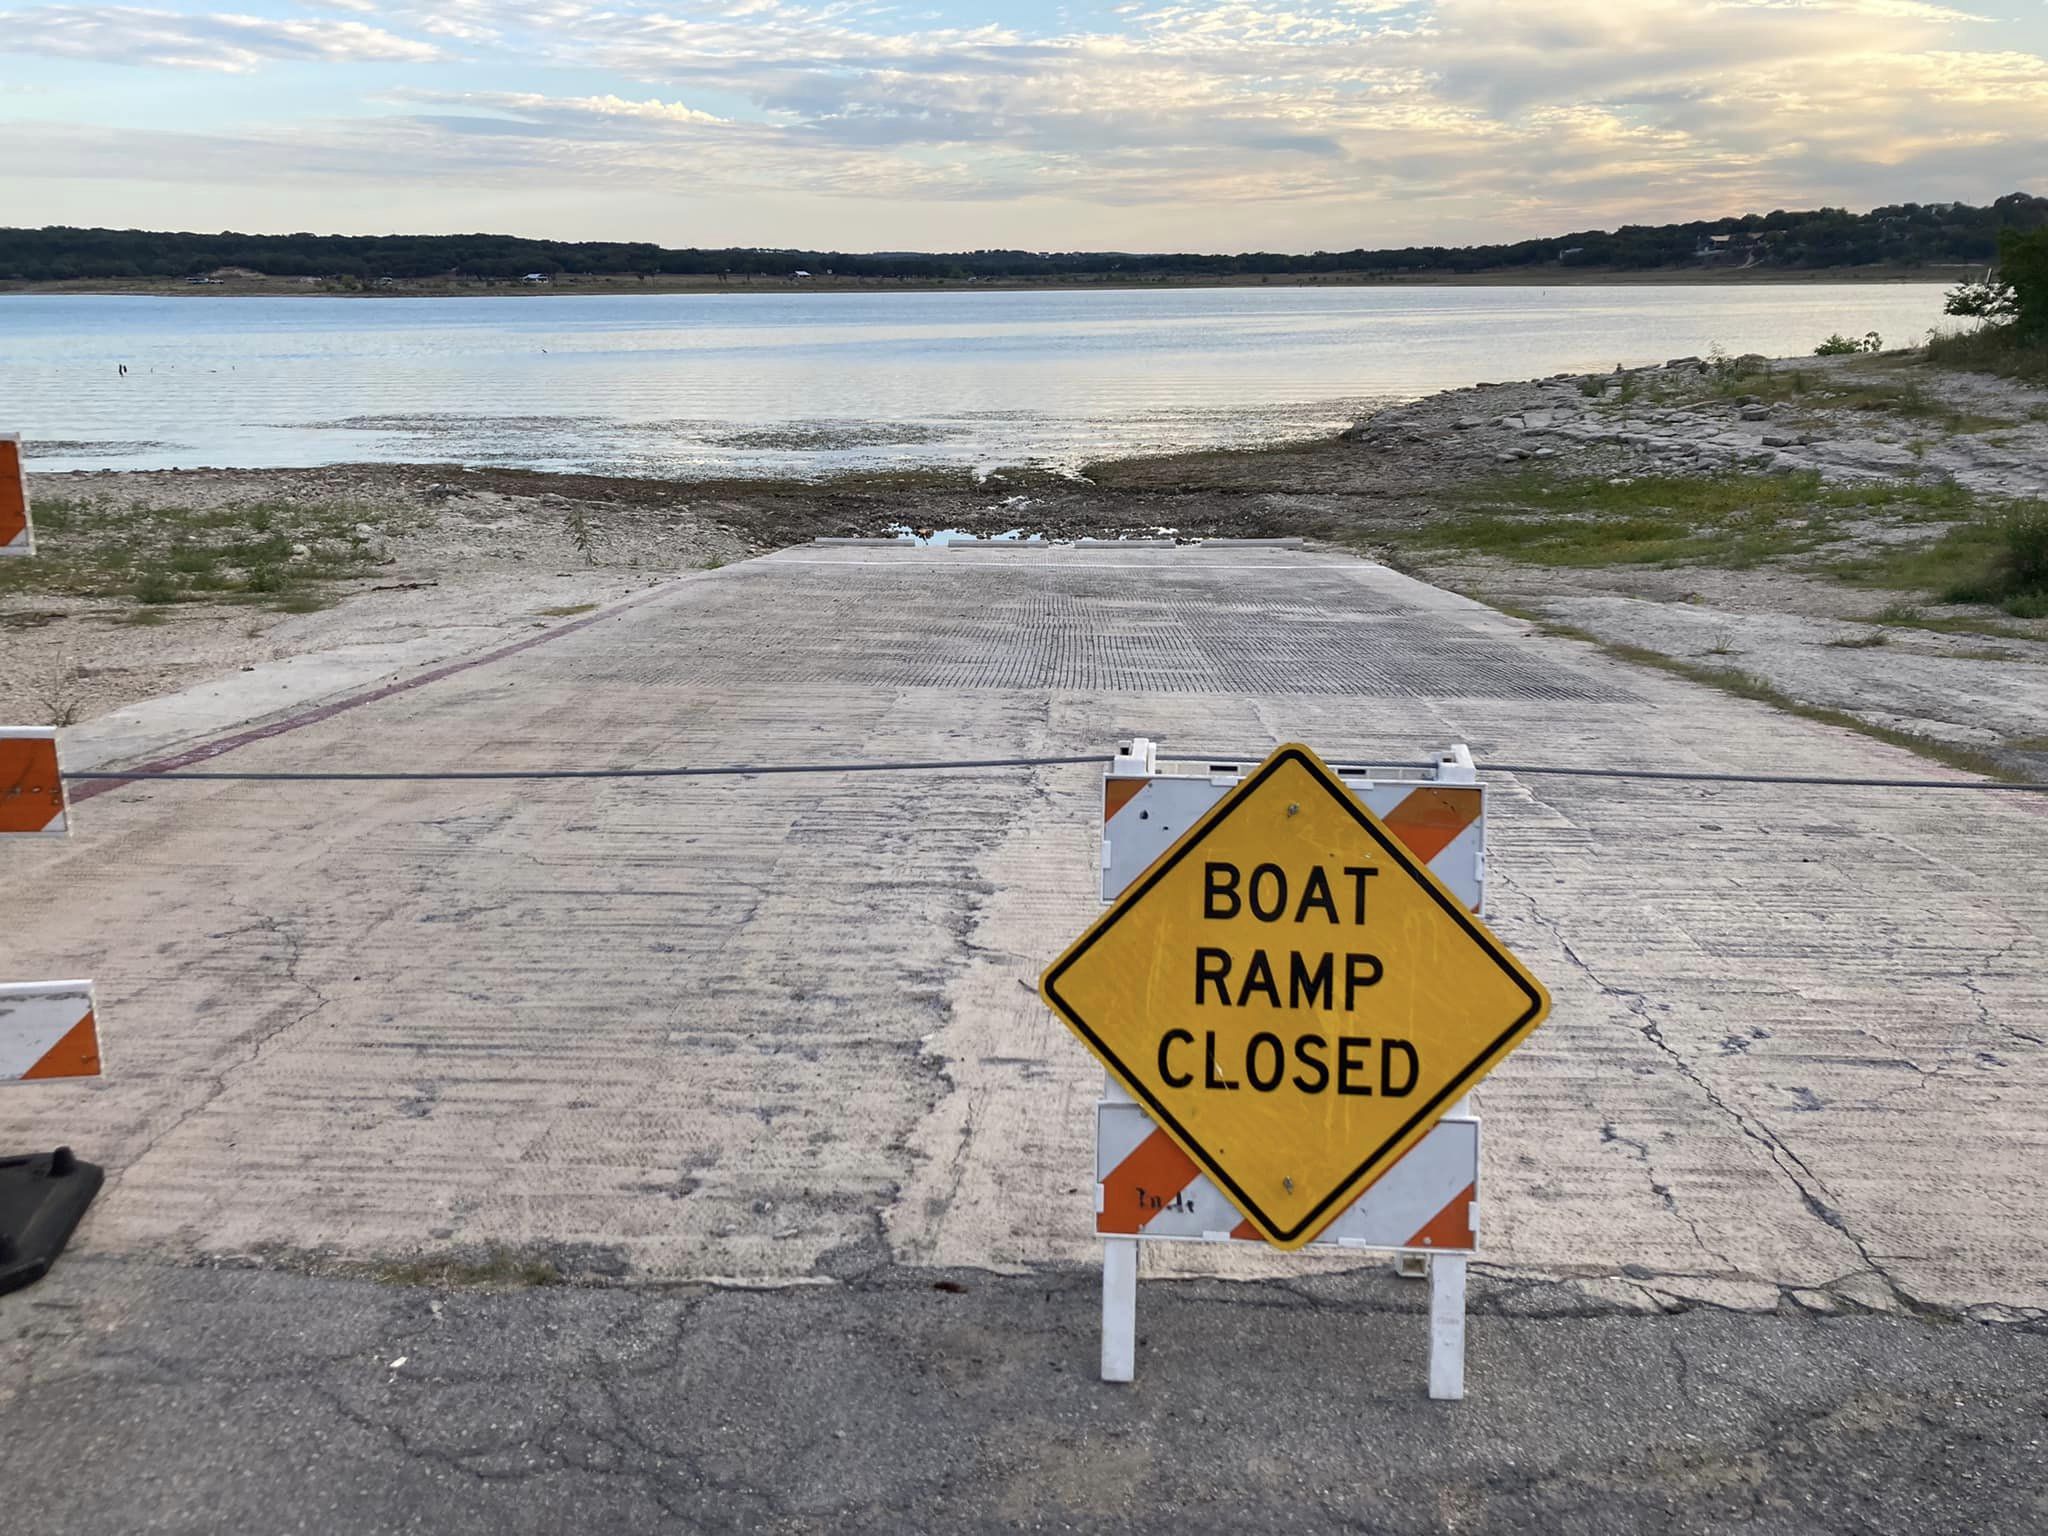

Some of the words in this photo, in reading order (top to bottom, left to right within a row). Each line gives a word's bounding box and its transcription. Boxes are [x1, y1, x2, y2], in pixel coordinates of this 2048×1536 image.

[1204, 862, 1378, 925] BOAT
[1195, 947, 1383, 1011] RAMP
[1158, 1029, 1419, 1098] CLOSED
